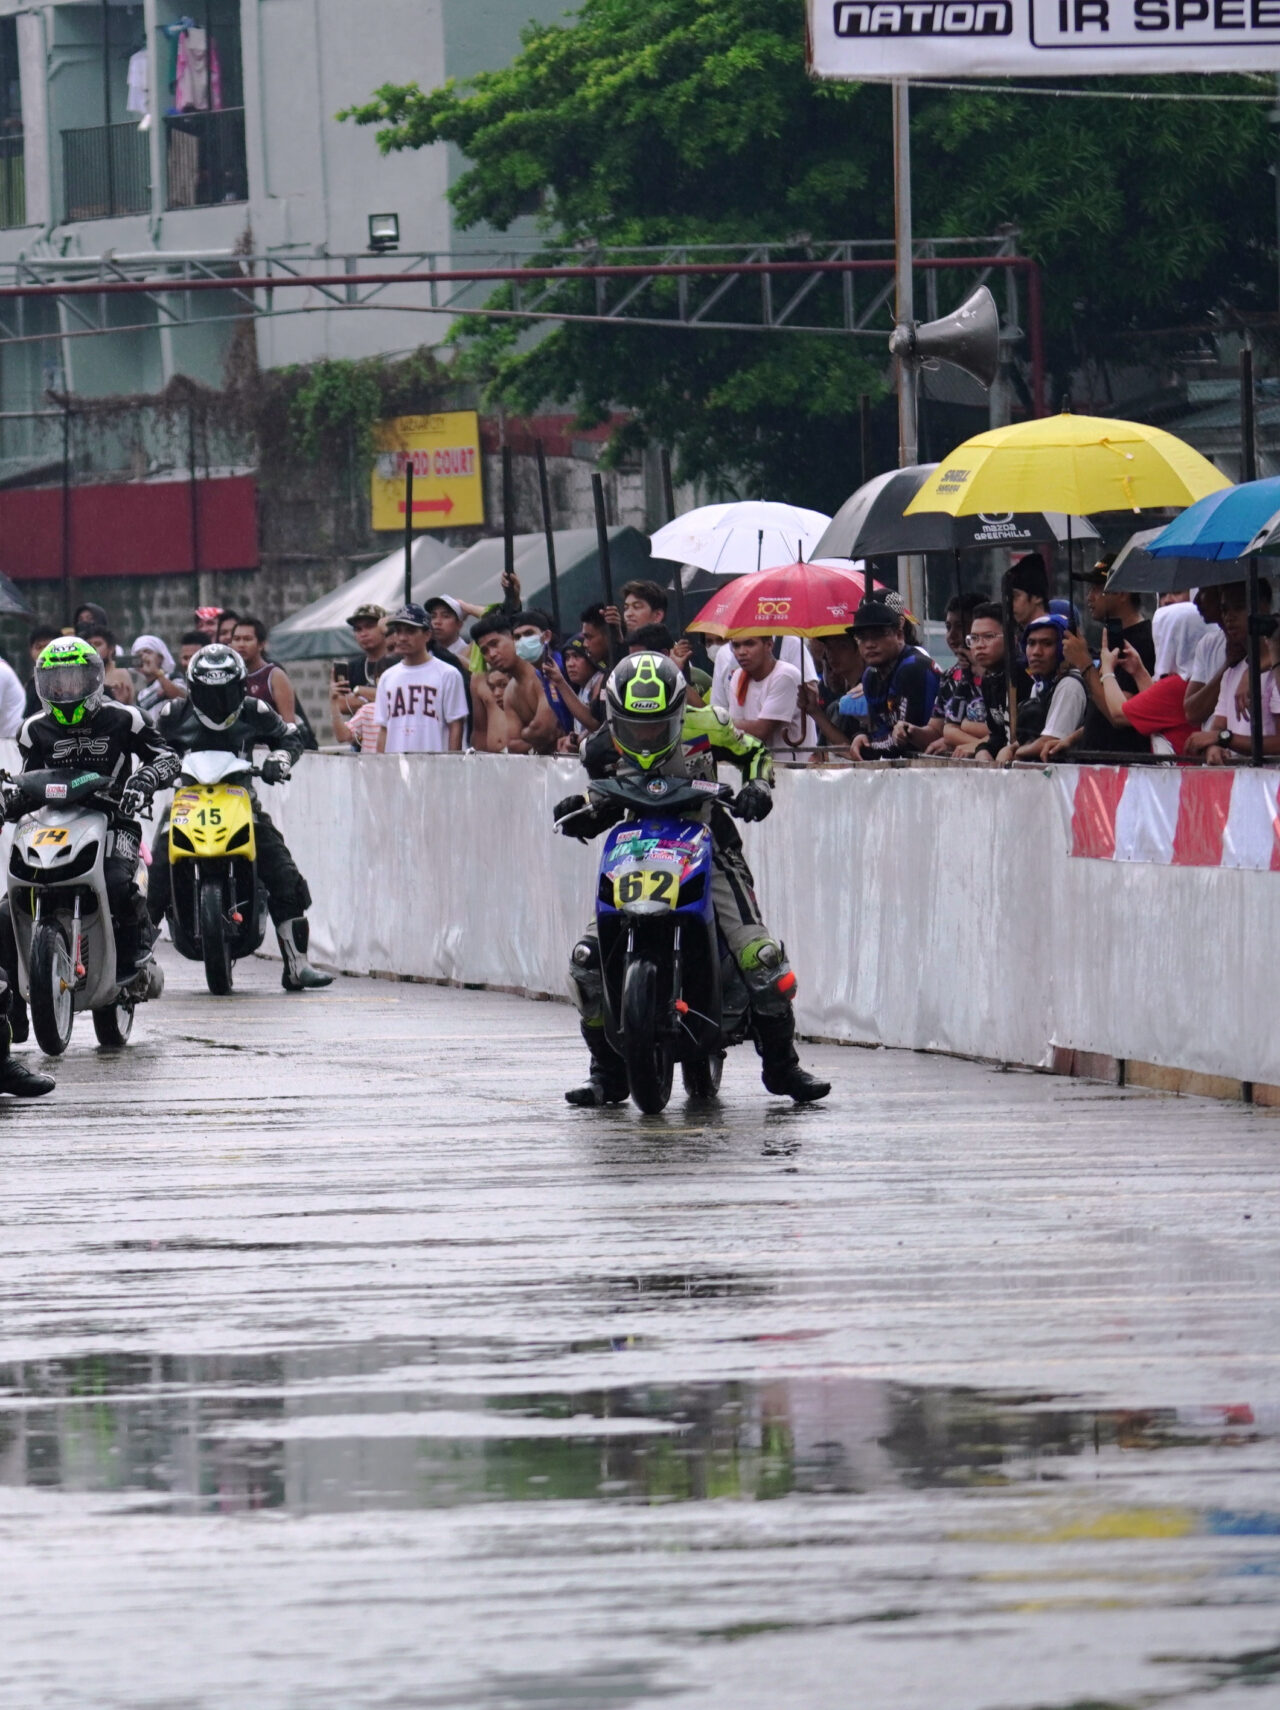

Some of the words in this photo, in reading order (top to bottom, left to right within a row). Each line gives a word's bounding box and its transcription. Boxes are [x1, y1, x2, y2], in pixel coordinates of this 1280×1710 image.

[1059, 0, 1109, 32] IR
[433, 447, 475, 475] COURT
[757, 601, 790, 615] 100
[197, 807, 222, 826] 15
[34, 829, 69, 846] 14
[619, 871, 674, 904] 62
